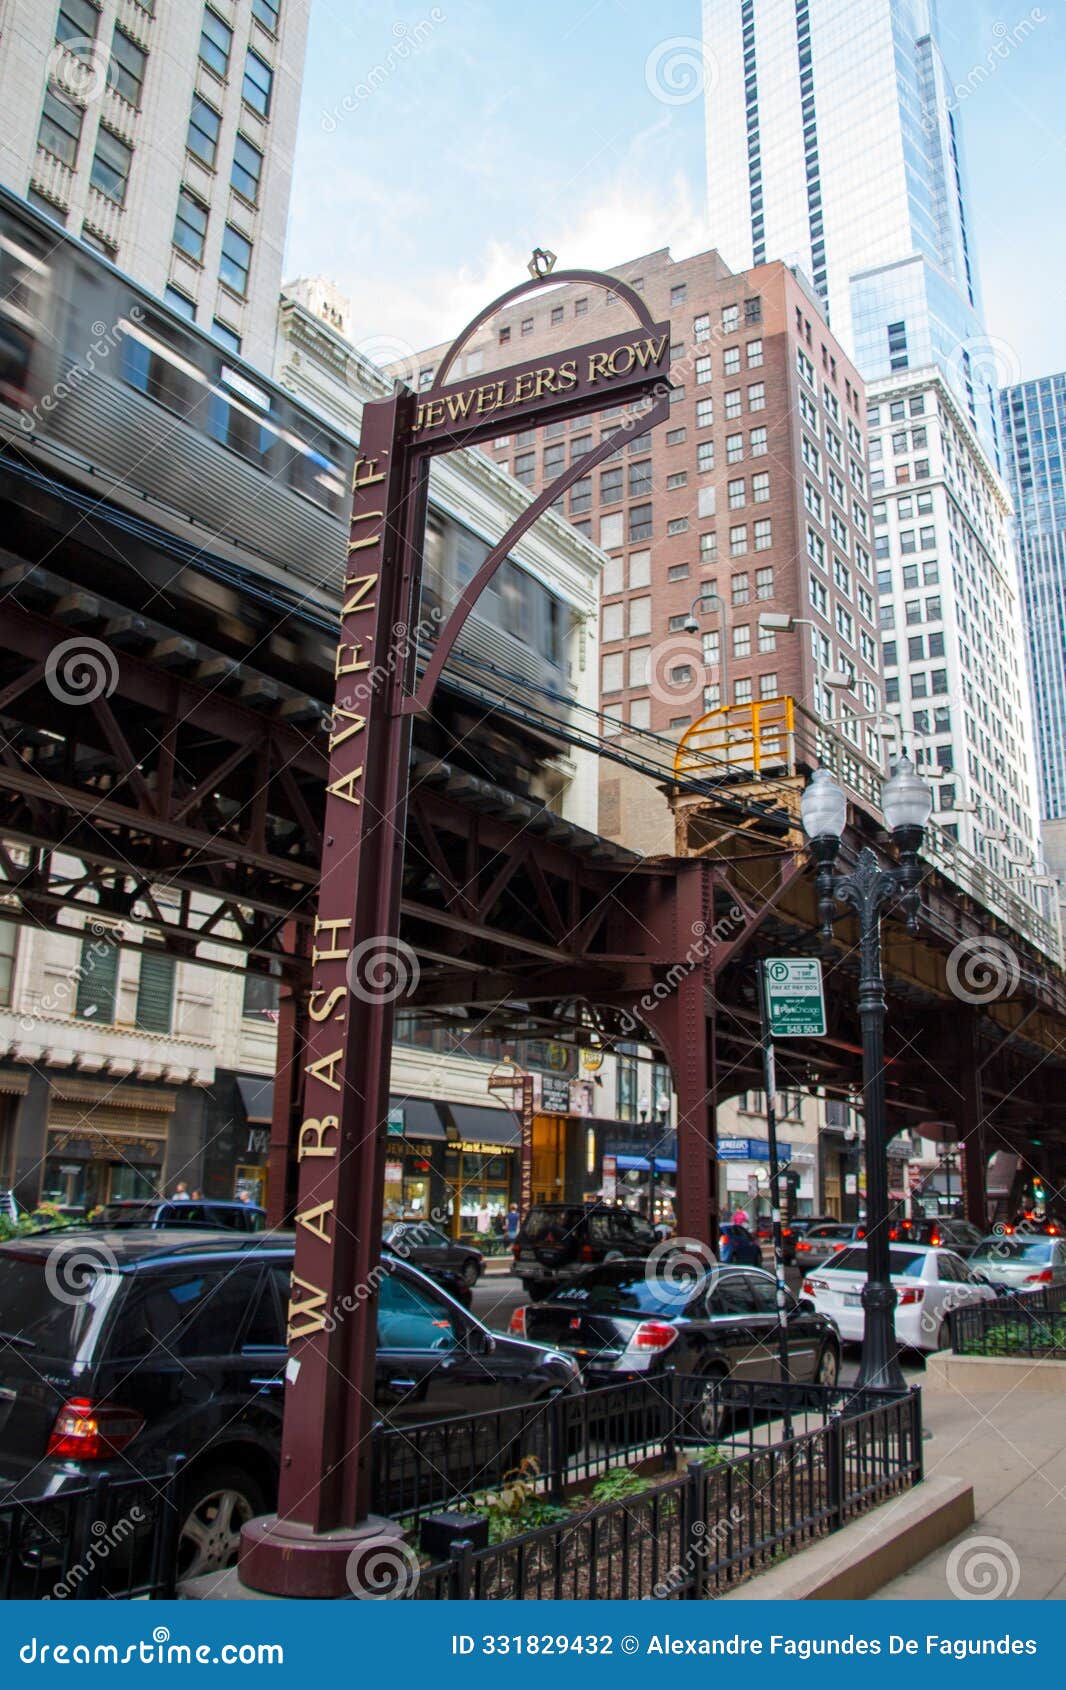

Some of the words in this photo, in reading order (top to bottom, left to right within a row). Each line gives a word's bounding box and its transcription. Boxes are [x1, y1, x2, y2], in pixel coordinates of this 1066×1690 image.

[411, 360, 578, 432] JEWELERS
[587, 335, 668, 382] ROW
[325, 450, 389, 806] AVENUE
[286, 915, 353, 1347] WABASH
